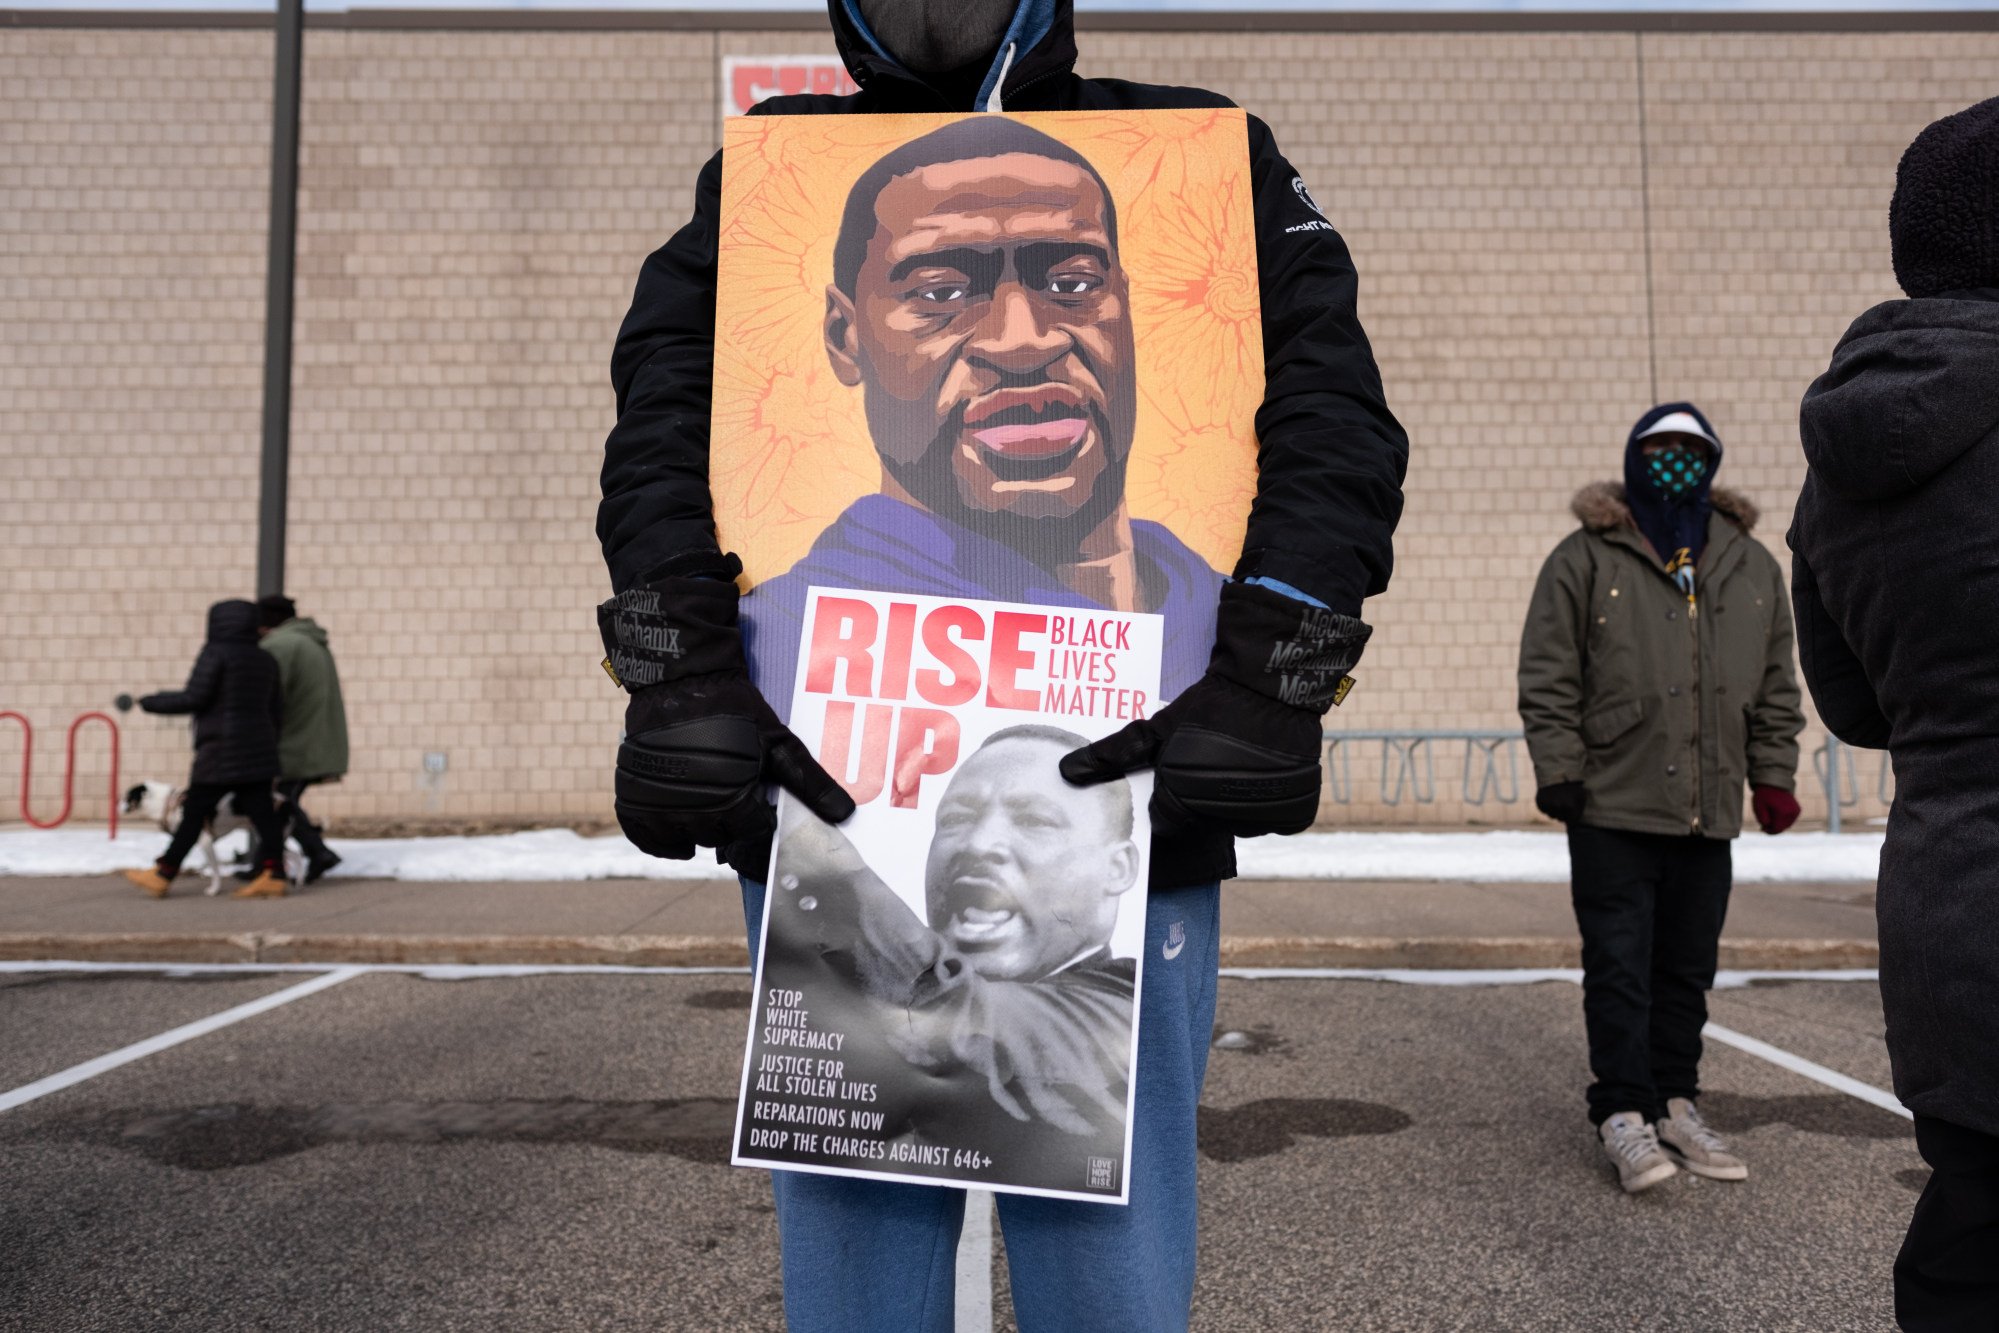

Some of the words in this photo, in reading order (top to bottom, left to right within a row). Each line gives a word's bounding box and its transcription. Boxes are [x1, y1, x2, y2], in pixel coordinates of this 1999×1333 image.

[1050, 615, 1132, 651] BLACK
[805, 595, 1048, 712] RISE
[1047, 649, 1117, 684] LIVES
[1044, 683, 1147, 720] MATTER
[818, 699, 961, 810] UP
[768, 988, 803, 1008] STOP
[766, 1008, 808, 1029] WHITE
[763, 1027, 844, 1051] SUPREMACY
[758, 1054, 812, 1076] JUSTICE
[817, 1059, 844, 1079] FOR
[756, 1074, 780, 1093] ALL
[785, 1076, 836, 1099] STOLEN
[840, 1082, 877, 1102] LIVES
[753, 1101, 846, 1128] REPARATIONS
[850, 1110, 885, 1131] NOW
[750, 1128, 789, 1150] DROP
[793, 1132, 819, 1153] THE
[823, 1135, 885, 1160] CHARGES
[889, 1142, 950, 1167] AGAINST
[953, 1148, 993, 1170] 646+
[1091, 1168, 1112, 1178] HOPE
[1092, 1159, 1112, 1169] LOVE
[1091, 1177, 1111, 1187] RISE
